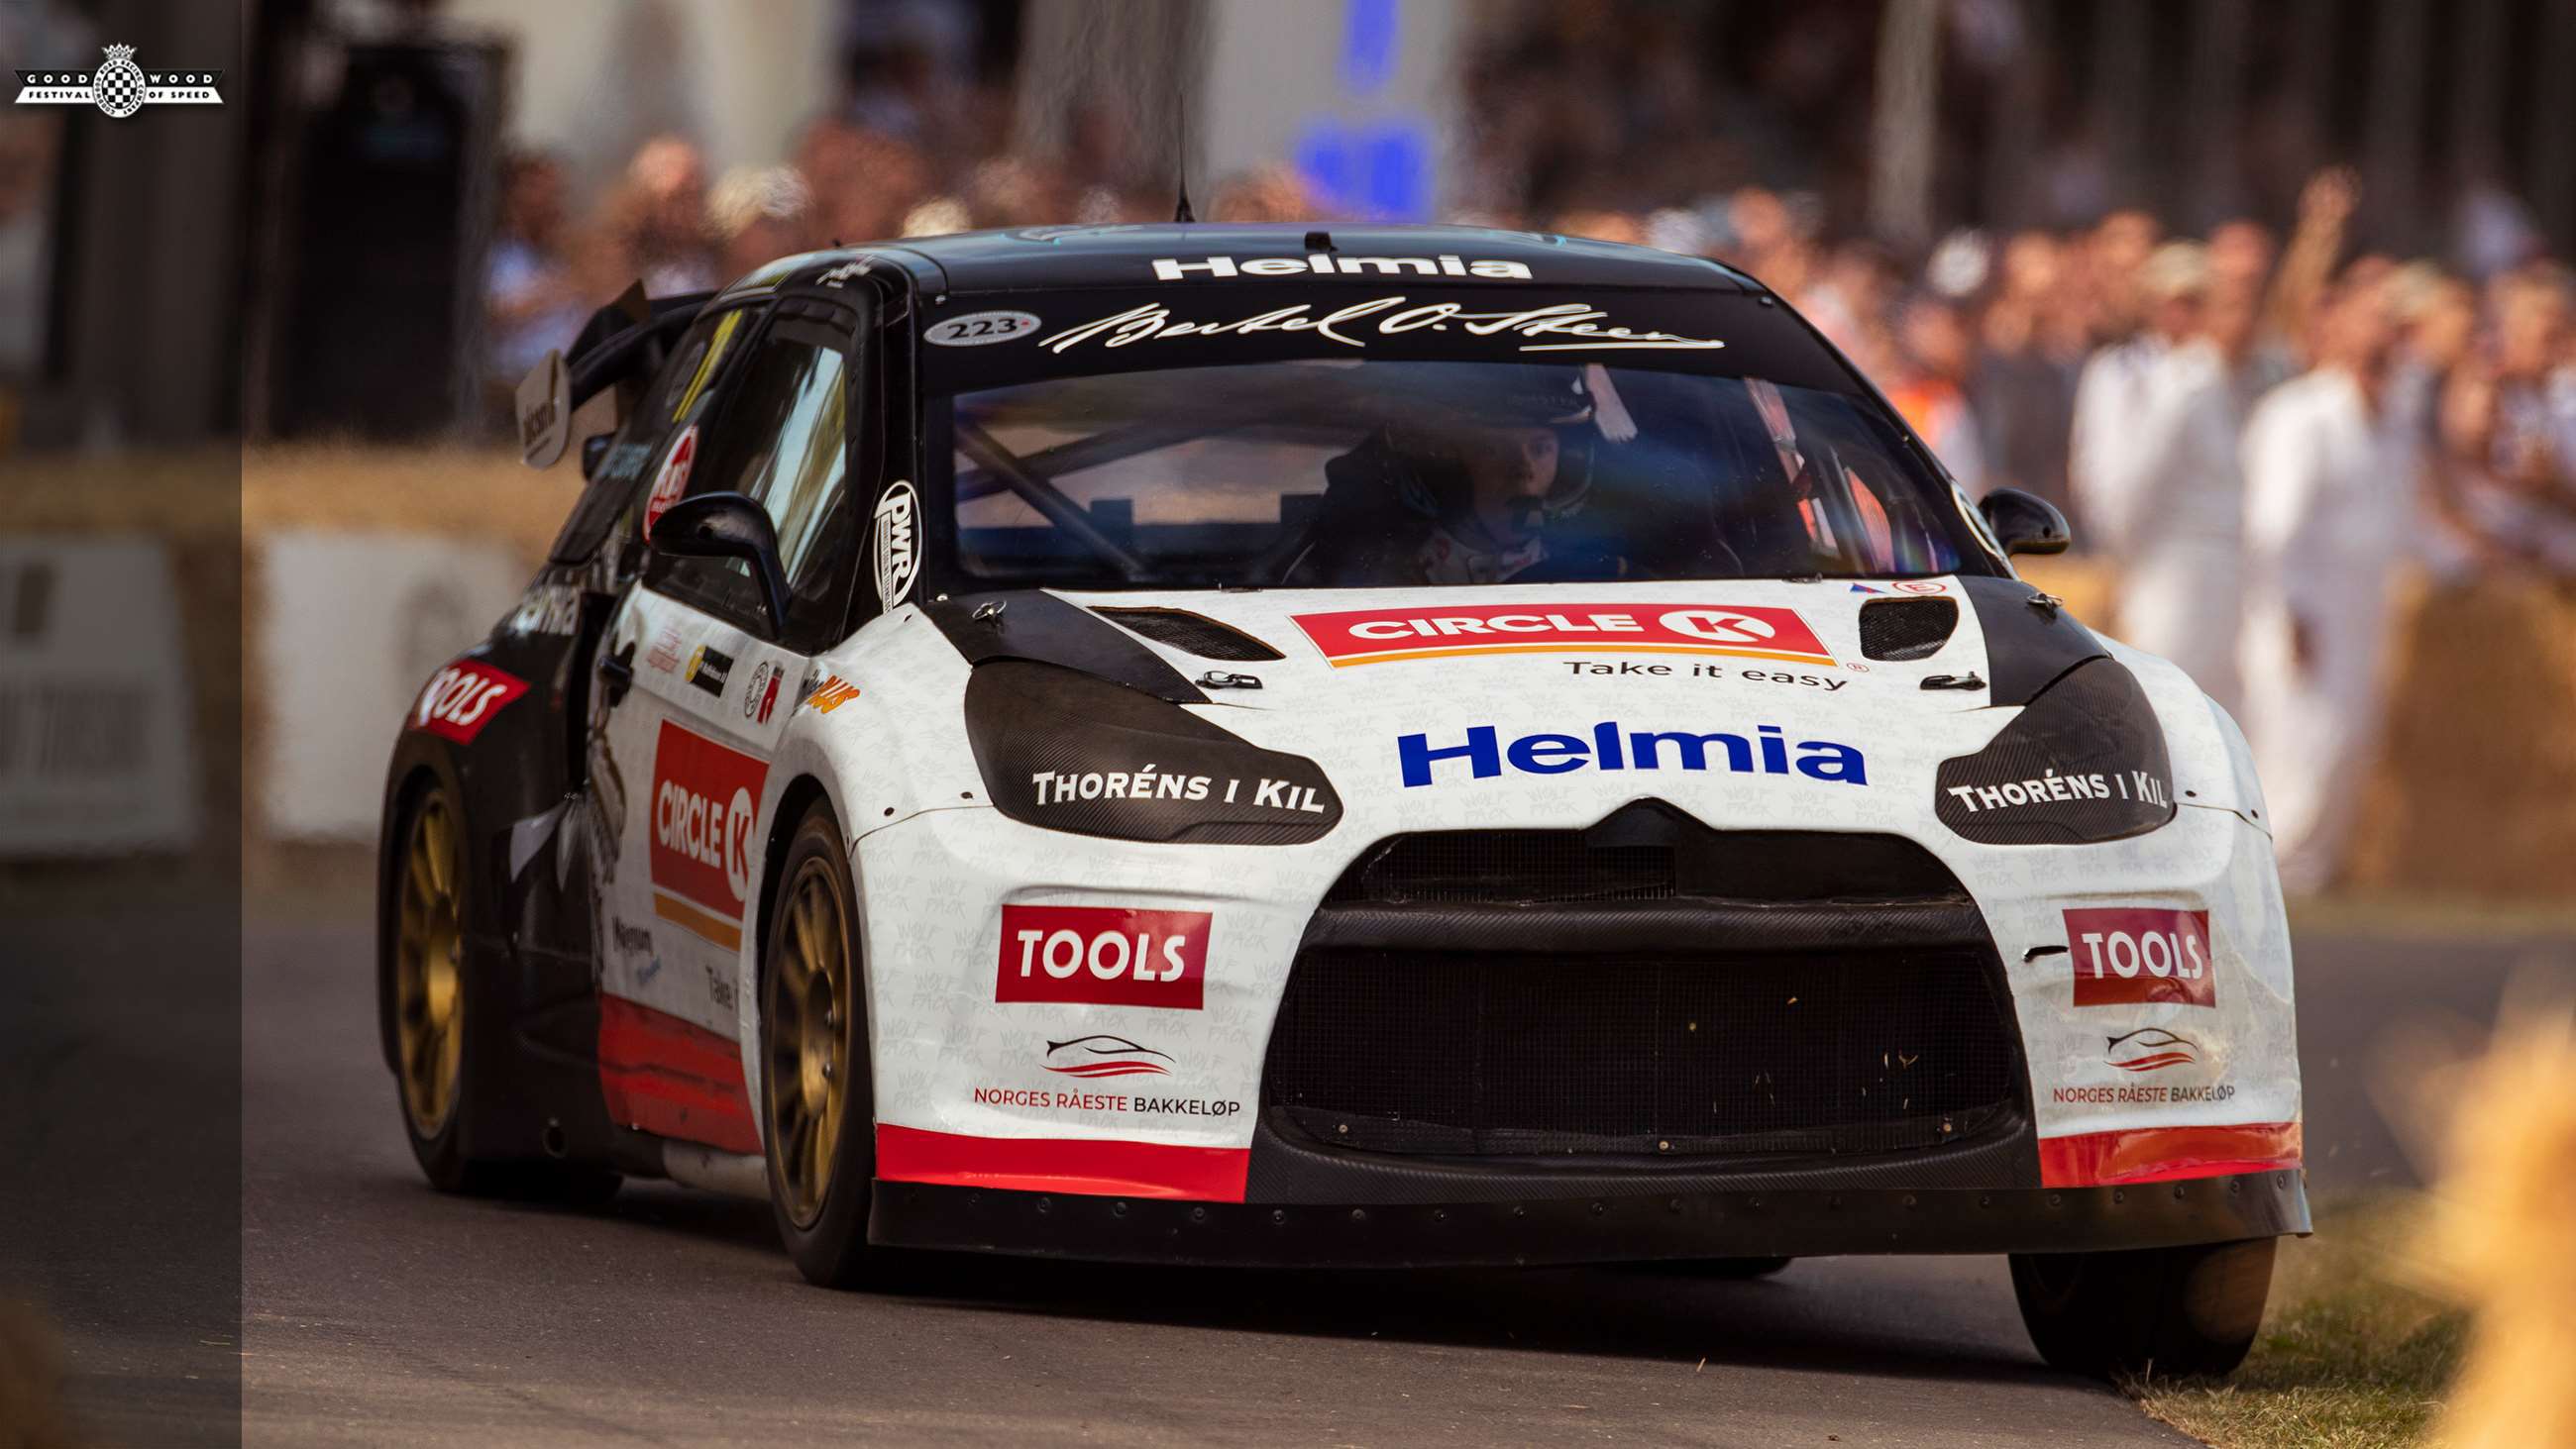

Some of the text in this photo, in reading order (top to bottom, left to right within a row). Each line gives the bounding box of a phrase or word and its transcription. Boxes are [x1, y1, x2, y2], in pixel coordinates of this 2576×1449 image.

[1151, 255, 1534, 280] Helmia
[946, 317, 1019, 340] 223
[876, 491, 912, 594] PWR
[1348, 614, 1765, 641] CIRCLE K
[1562, 662, 1849, 691] Take it easy
[1397, 722, 1869, 787] Helmia
[657, 778, 723, 869] CIRCLE
[1016, 929, 1186, 982] TOOLS
[2082, 931, 2203, 980] TOOLS
[974, 1087, 1240, 1117] NORGES RÅESTE BAKKELØP
[2054, 1083, 2235, 1102] NORGES RÅESTE BAKKELØP
